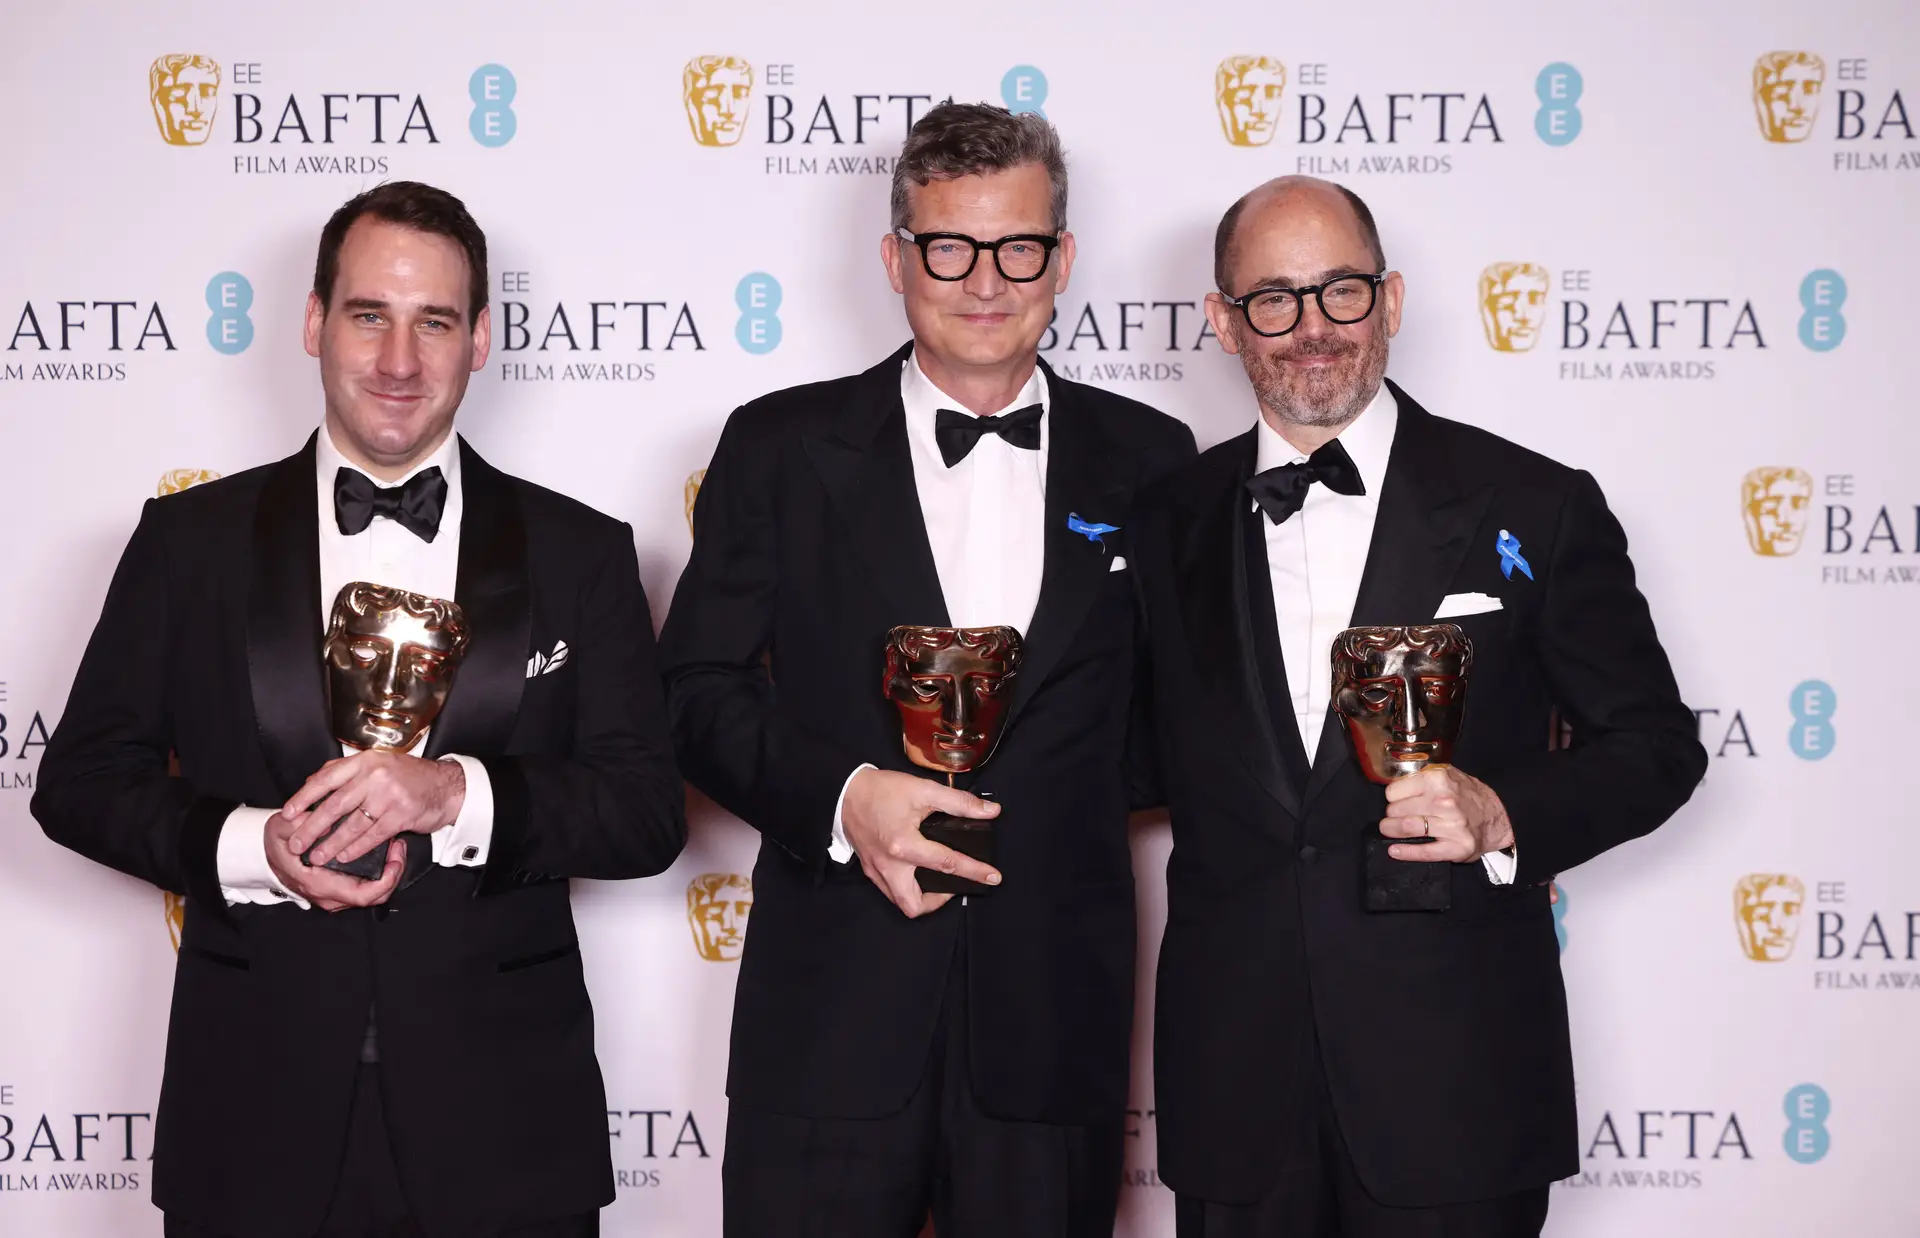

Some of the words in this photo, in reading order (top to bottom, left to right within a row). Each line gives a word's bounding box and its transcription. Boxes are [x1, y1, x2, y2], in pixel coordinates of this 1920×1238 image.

[234, 63, 261, 83] EE
[766, 64, 793, 85] EE
[1299, 63, 1327, 85] EE
[1838, 58, 1867, 80] EE
[233, 93, 440, 144] BAFTA
[765, 94, 953, 144] BAFT
[1297, 93, 1504, 144] BAFTA
[234, 156, 286, 174] FILM
[294, 156, 389, 174] AWARDS
[765, 156, 818, 174] FILM
[1297, 156, 1350, 174] FILM
[1357, 155, 1452, 174] AWARDS
[1833, 151, 1888, 170] FILM
[502, 271, 530, 292] EE
[1562, 270, 1591, 291] EE
[500, 301, 707, 352] BAFTA
[1561, 299, 1768, 350] BAFTA
[31, 363, 126, 381] AWARDS
[501, 363, 554, 381] FILM
[562, 363, 655, 381] AWARDS
[1090, 363, 1184, 381] AWARDS
[1559, 361, 1613, 380] FILM
[1620, 361, 1716, 380] AWARDS
[1825, 474, 1854, 496] EE
[1822, 566, 1876, 584] FILM
[1816, 881, 1845, 903] EE
[1814, 971, 1869, 990] FILM
[0, 1113, 154, 1162] BAFT
[1585, 1110, 1755, 1160] AFTA
[46, 1173, 140, 1191] AWARDS
[1607, 1169, 1702, 1189] AWARDS
